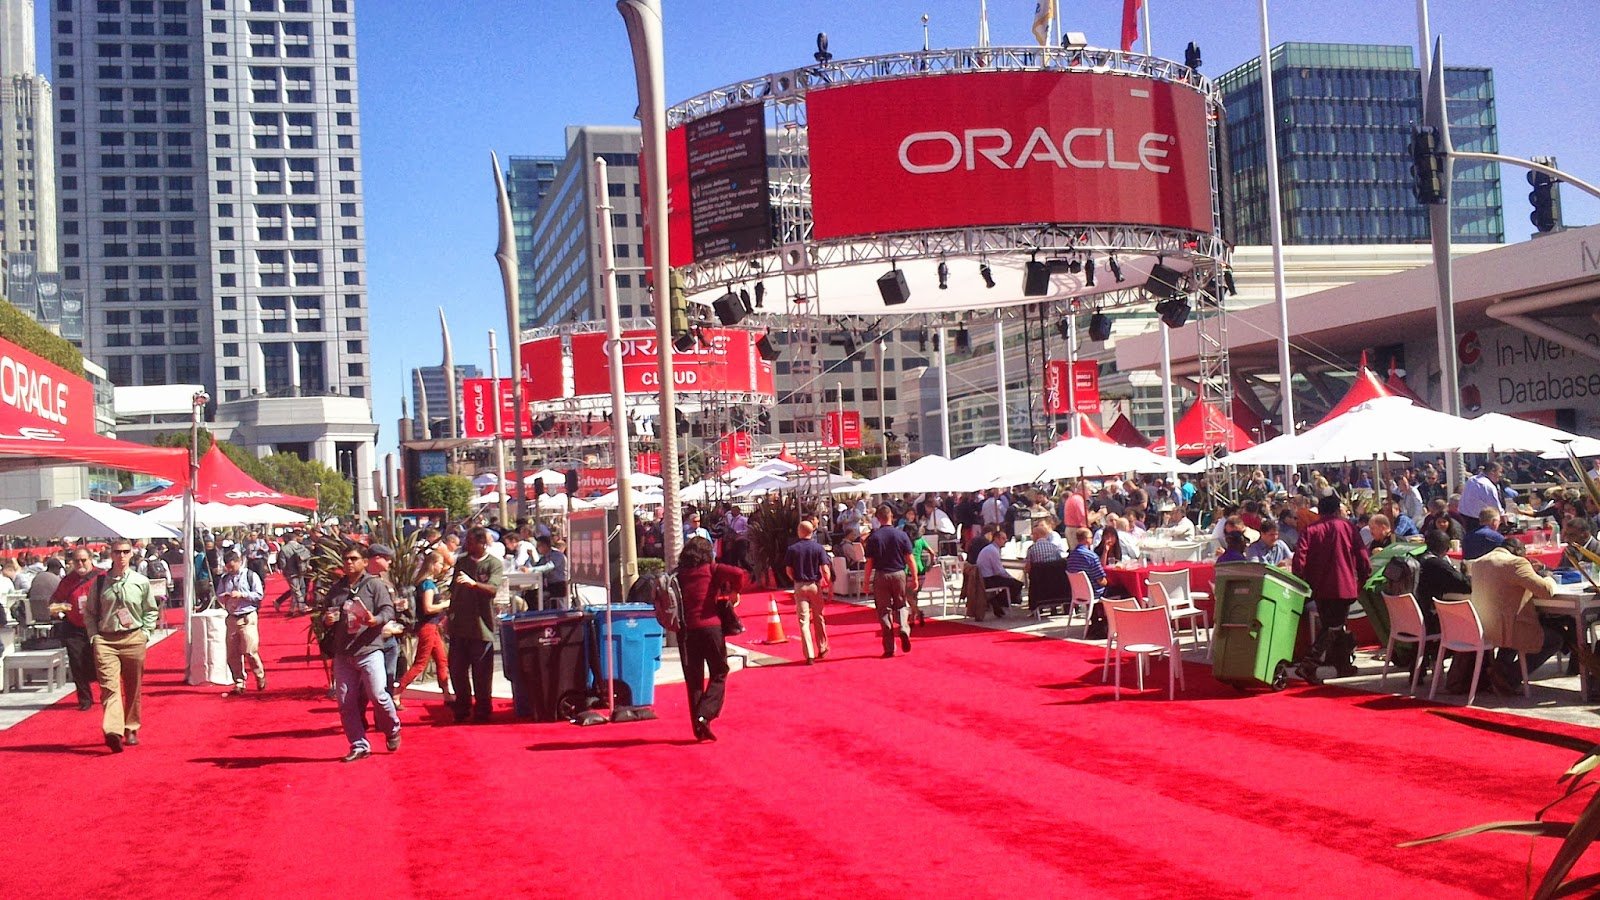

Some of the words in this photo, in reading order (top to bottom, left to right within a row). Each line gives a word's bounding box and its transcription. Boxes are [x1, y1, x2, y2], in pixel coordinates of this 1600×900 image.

[898, 127, 1171, 174] ORACLE
[0, 355, 69, 425] ORACLE
[641, 371, 697, 385] CLUD
[1498, 372, 1600, 405] Database
